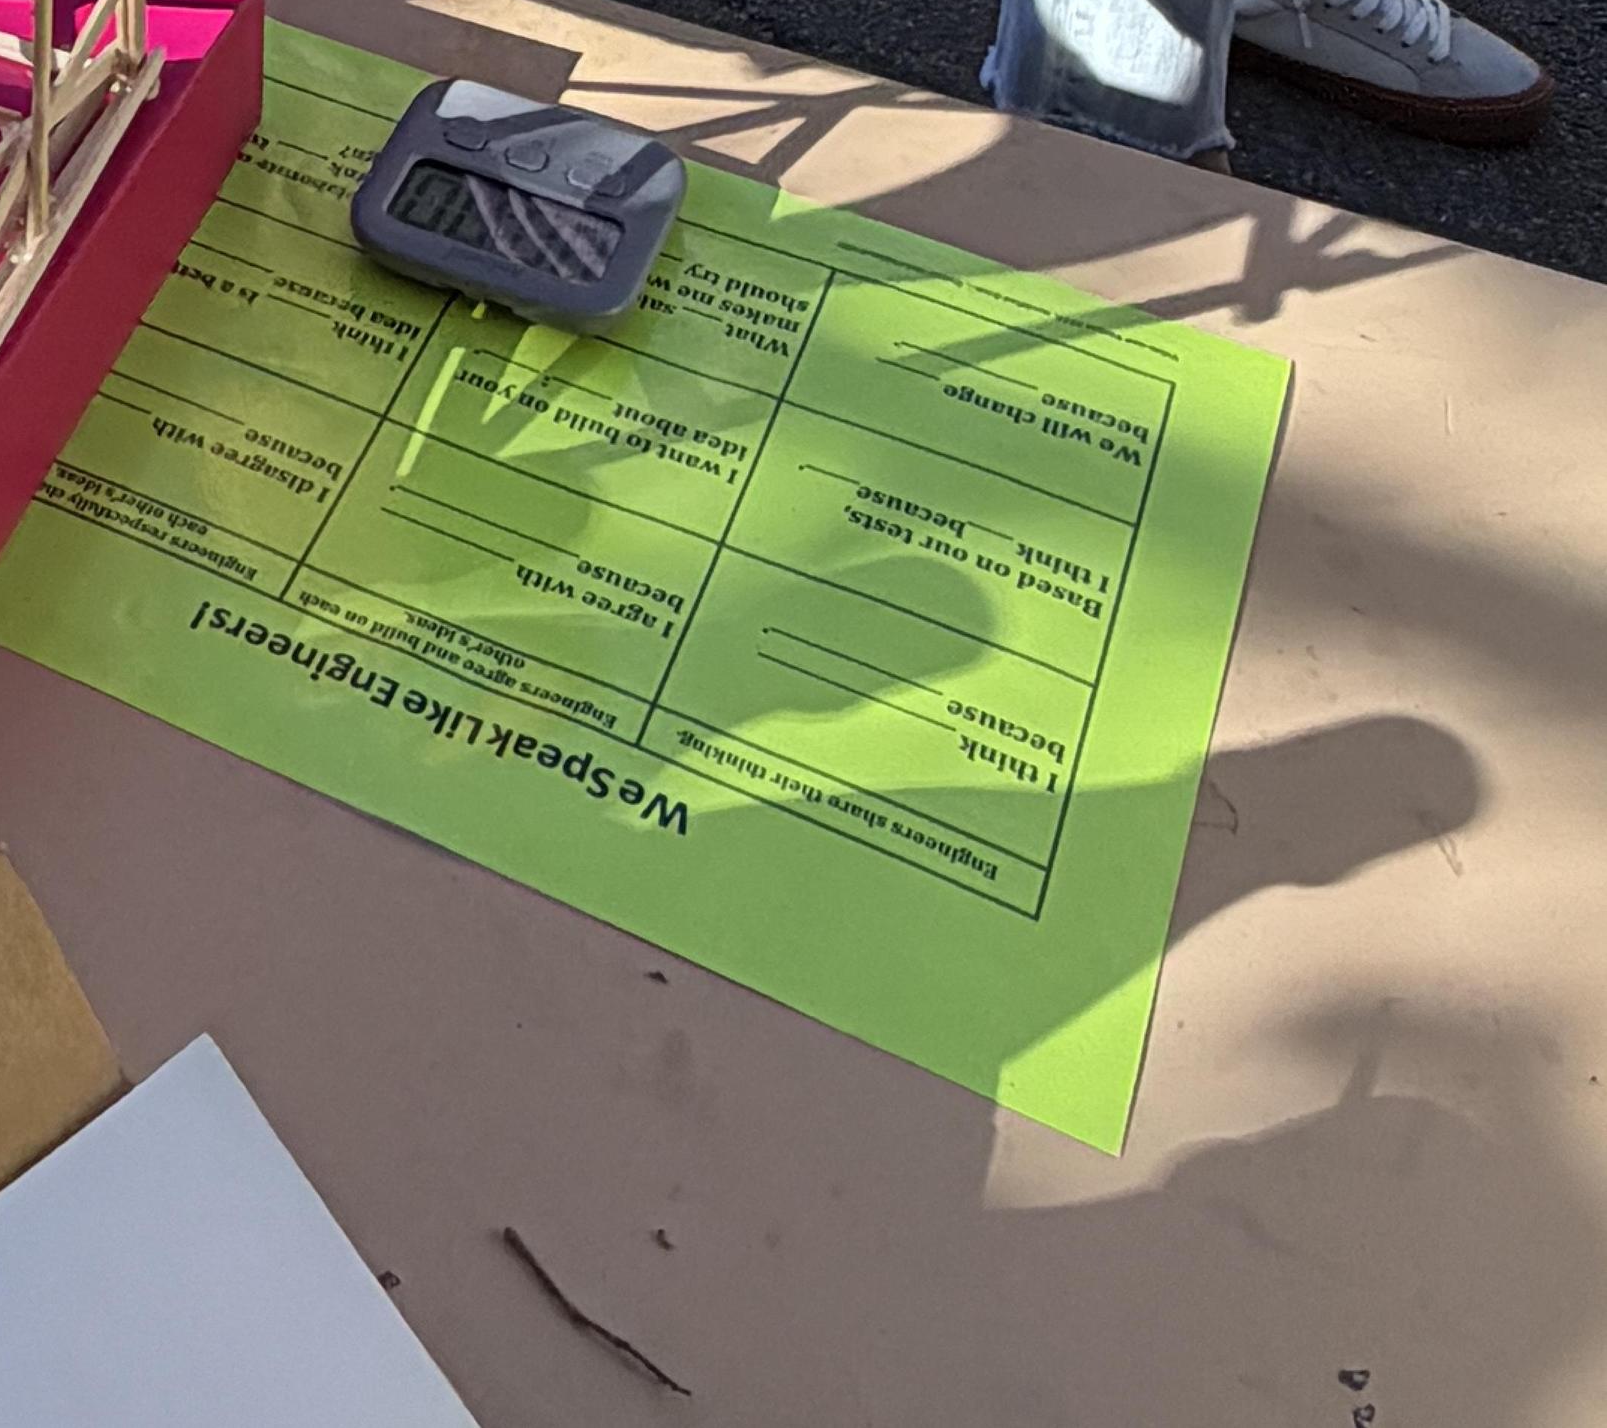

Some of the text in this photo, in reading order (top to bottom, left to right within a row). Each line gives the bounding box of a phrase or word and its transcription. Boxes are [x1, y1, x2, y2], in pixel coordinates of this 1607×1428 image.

[683, 263, 721, 287] try
[724, 277, 810, 314] should
[171, 260, 409, 363] I think is a bett
[273, 276, 422, 342] idea because
[637, 294, 789, 358] What sai
[676, 285, 801, 334] makes me
[451, 369, 739, 485] I want to build on your
[612, 402, 748, 463] idea about
[942, 384, 1142, 467] We will change
[1041, 393, 1150, 445] because
[152, 416, 331, 504] I disagree with
[243, 428, 344, 482] because
[66, 491, 258, 582] Engineers respectfully
[166, 512, 208, 537] each
[855, 485, 1110, 594] I think because
[576, 559, 685, 615] because
[843, 504, 1104, 620] Based on our tests,
[516, 564, 675, 639] I agree with
[298, 590, 618, 737] Engineers agree and build on each
[403, 610, 526, 674] other's ideas.
[189, 601, 688, 836] We Speak Like Engineers!
[946, 699, 1066, 765] because
[959, 734, 1059, 794] I think
[676, 730, 999, 881] Engineers share their thinking.
